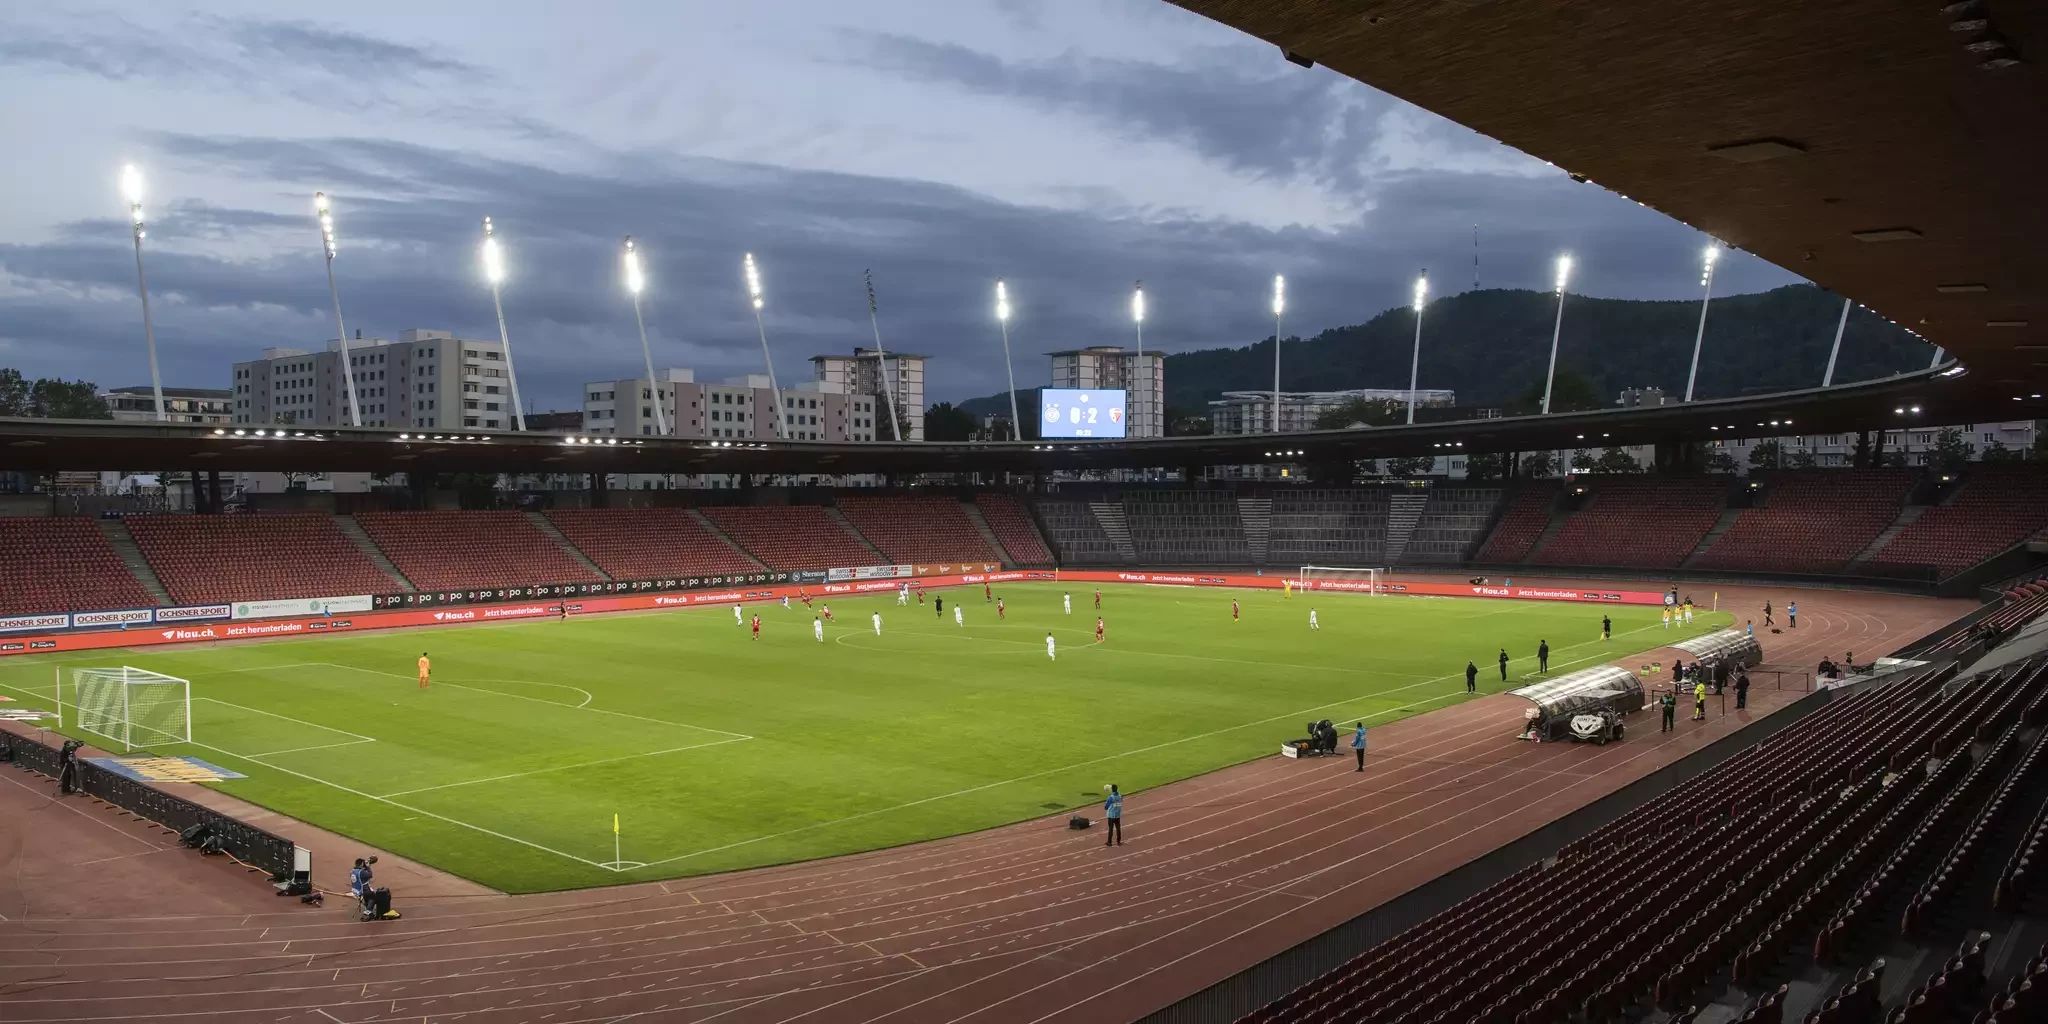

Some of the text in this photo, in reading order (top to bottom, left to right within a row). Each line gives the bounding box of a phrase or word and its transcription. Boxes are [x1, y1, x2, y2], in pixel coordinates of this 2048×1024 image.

[1482, 587, 1509, 595] Nau.ch
[1533, 590, 1577, 598] herunterladen
[664, 596, 687, 604] Nau.ch
[708, 593, 742, 601] herunterladen
[77, 611, 149, 623] OCHSNER SPORT
[160, 607, 228, 617] OCHSNER SPORT
[445, 611, 475, 620] Nau.ch
[500, 607, 544, 616] herunterladen
[0, 617, 65, 628] CHSNER SPORT
[176, 628, 214, 639] Nau.ch
[226, 627, 247, 636] Jetzt
[247, 623, 302, 634] herunterladen
